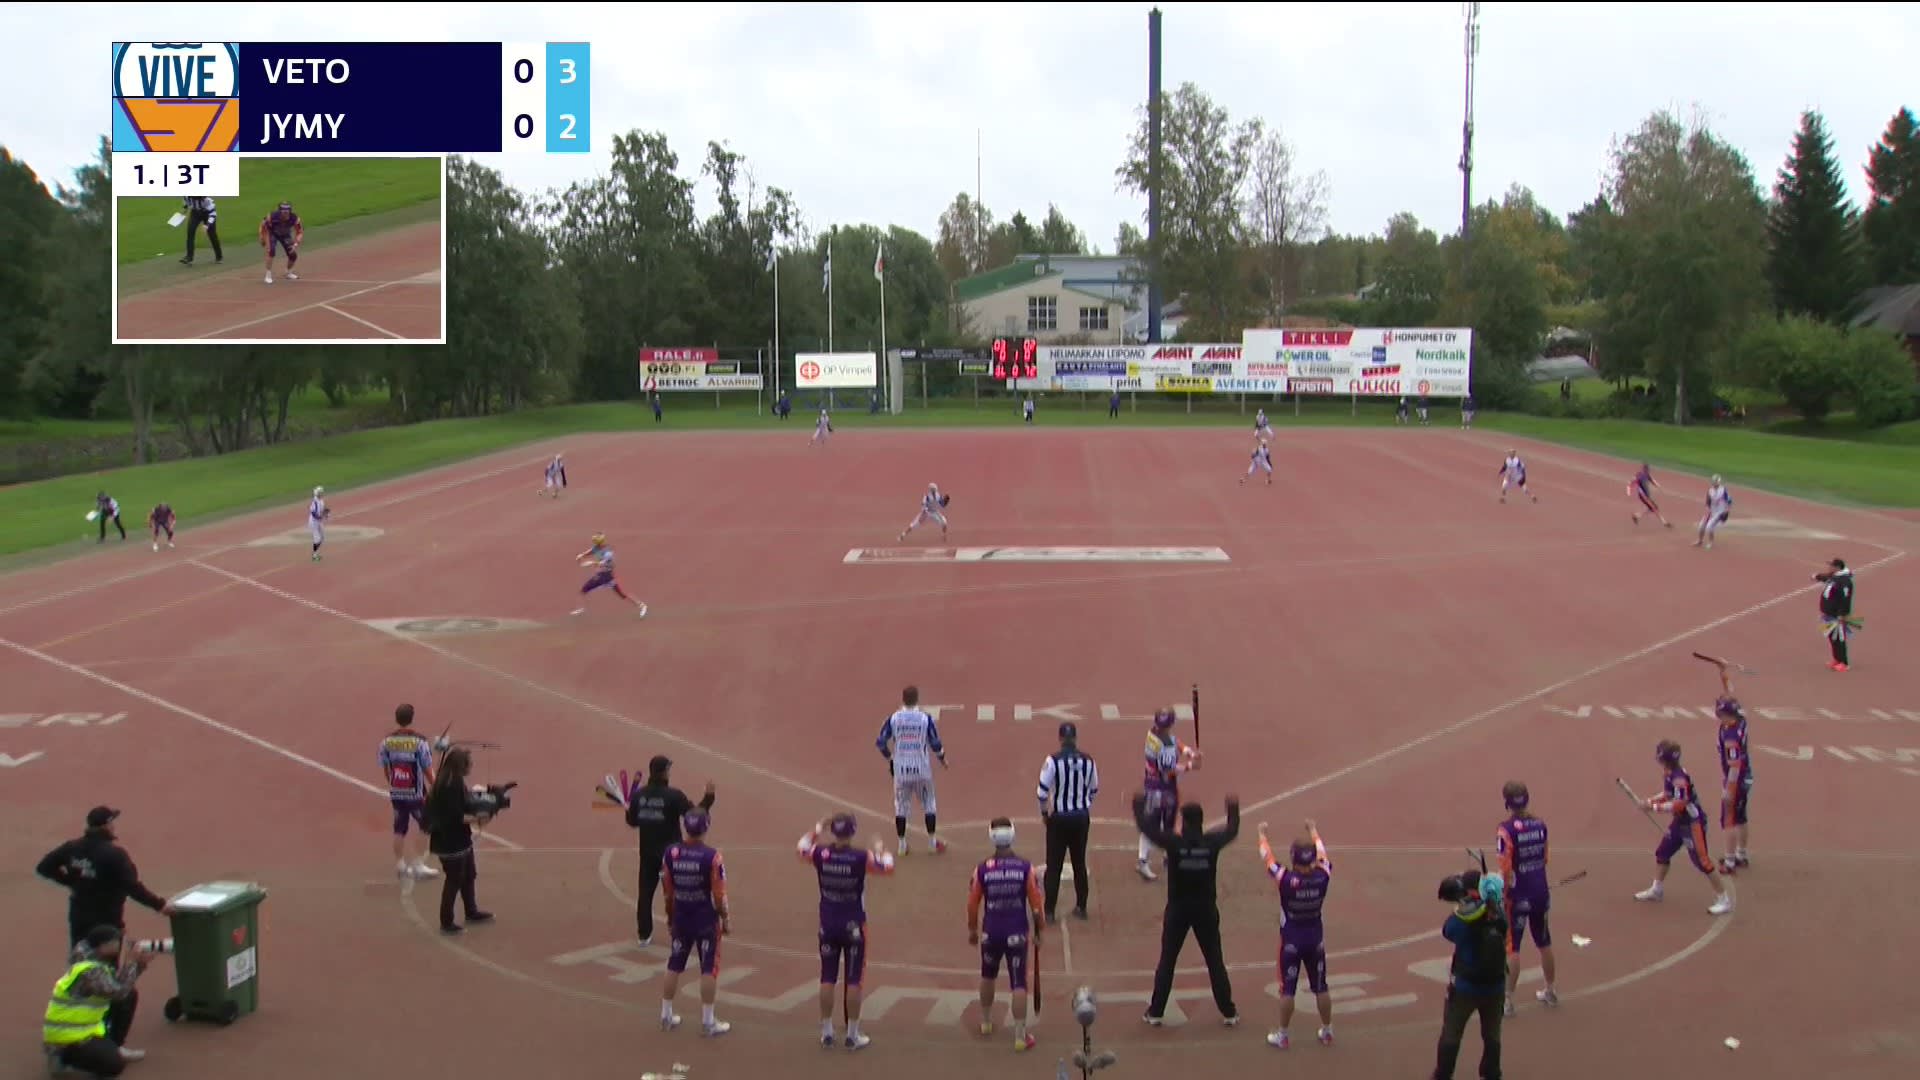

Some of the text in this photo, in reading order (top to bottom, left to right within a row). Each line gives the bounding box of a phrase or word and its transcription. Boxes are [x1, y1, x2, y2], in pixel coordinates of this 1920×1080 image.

[1290, 333, 1339, 345] TIKLI
[1395, 332, 1443, 343] HONPUMET
[1151, 347, 1194, 360] AVANT
[1200, 347, 1242, 360] AVANT
[1276, 350, 1331, 361] POWER OIL
[1415, 348, 1466, 361] Nordkalk
[823, 366, 872, 377] OP Vimpeli
